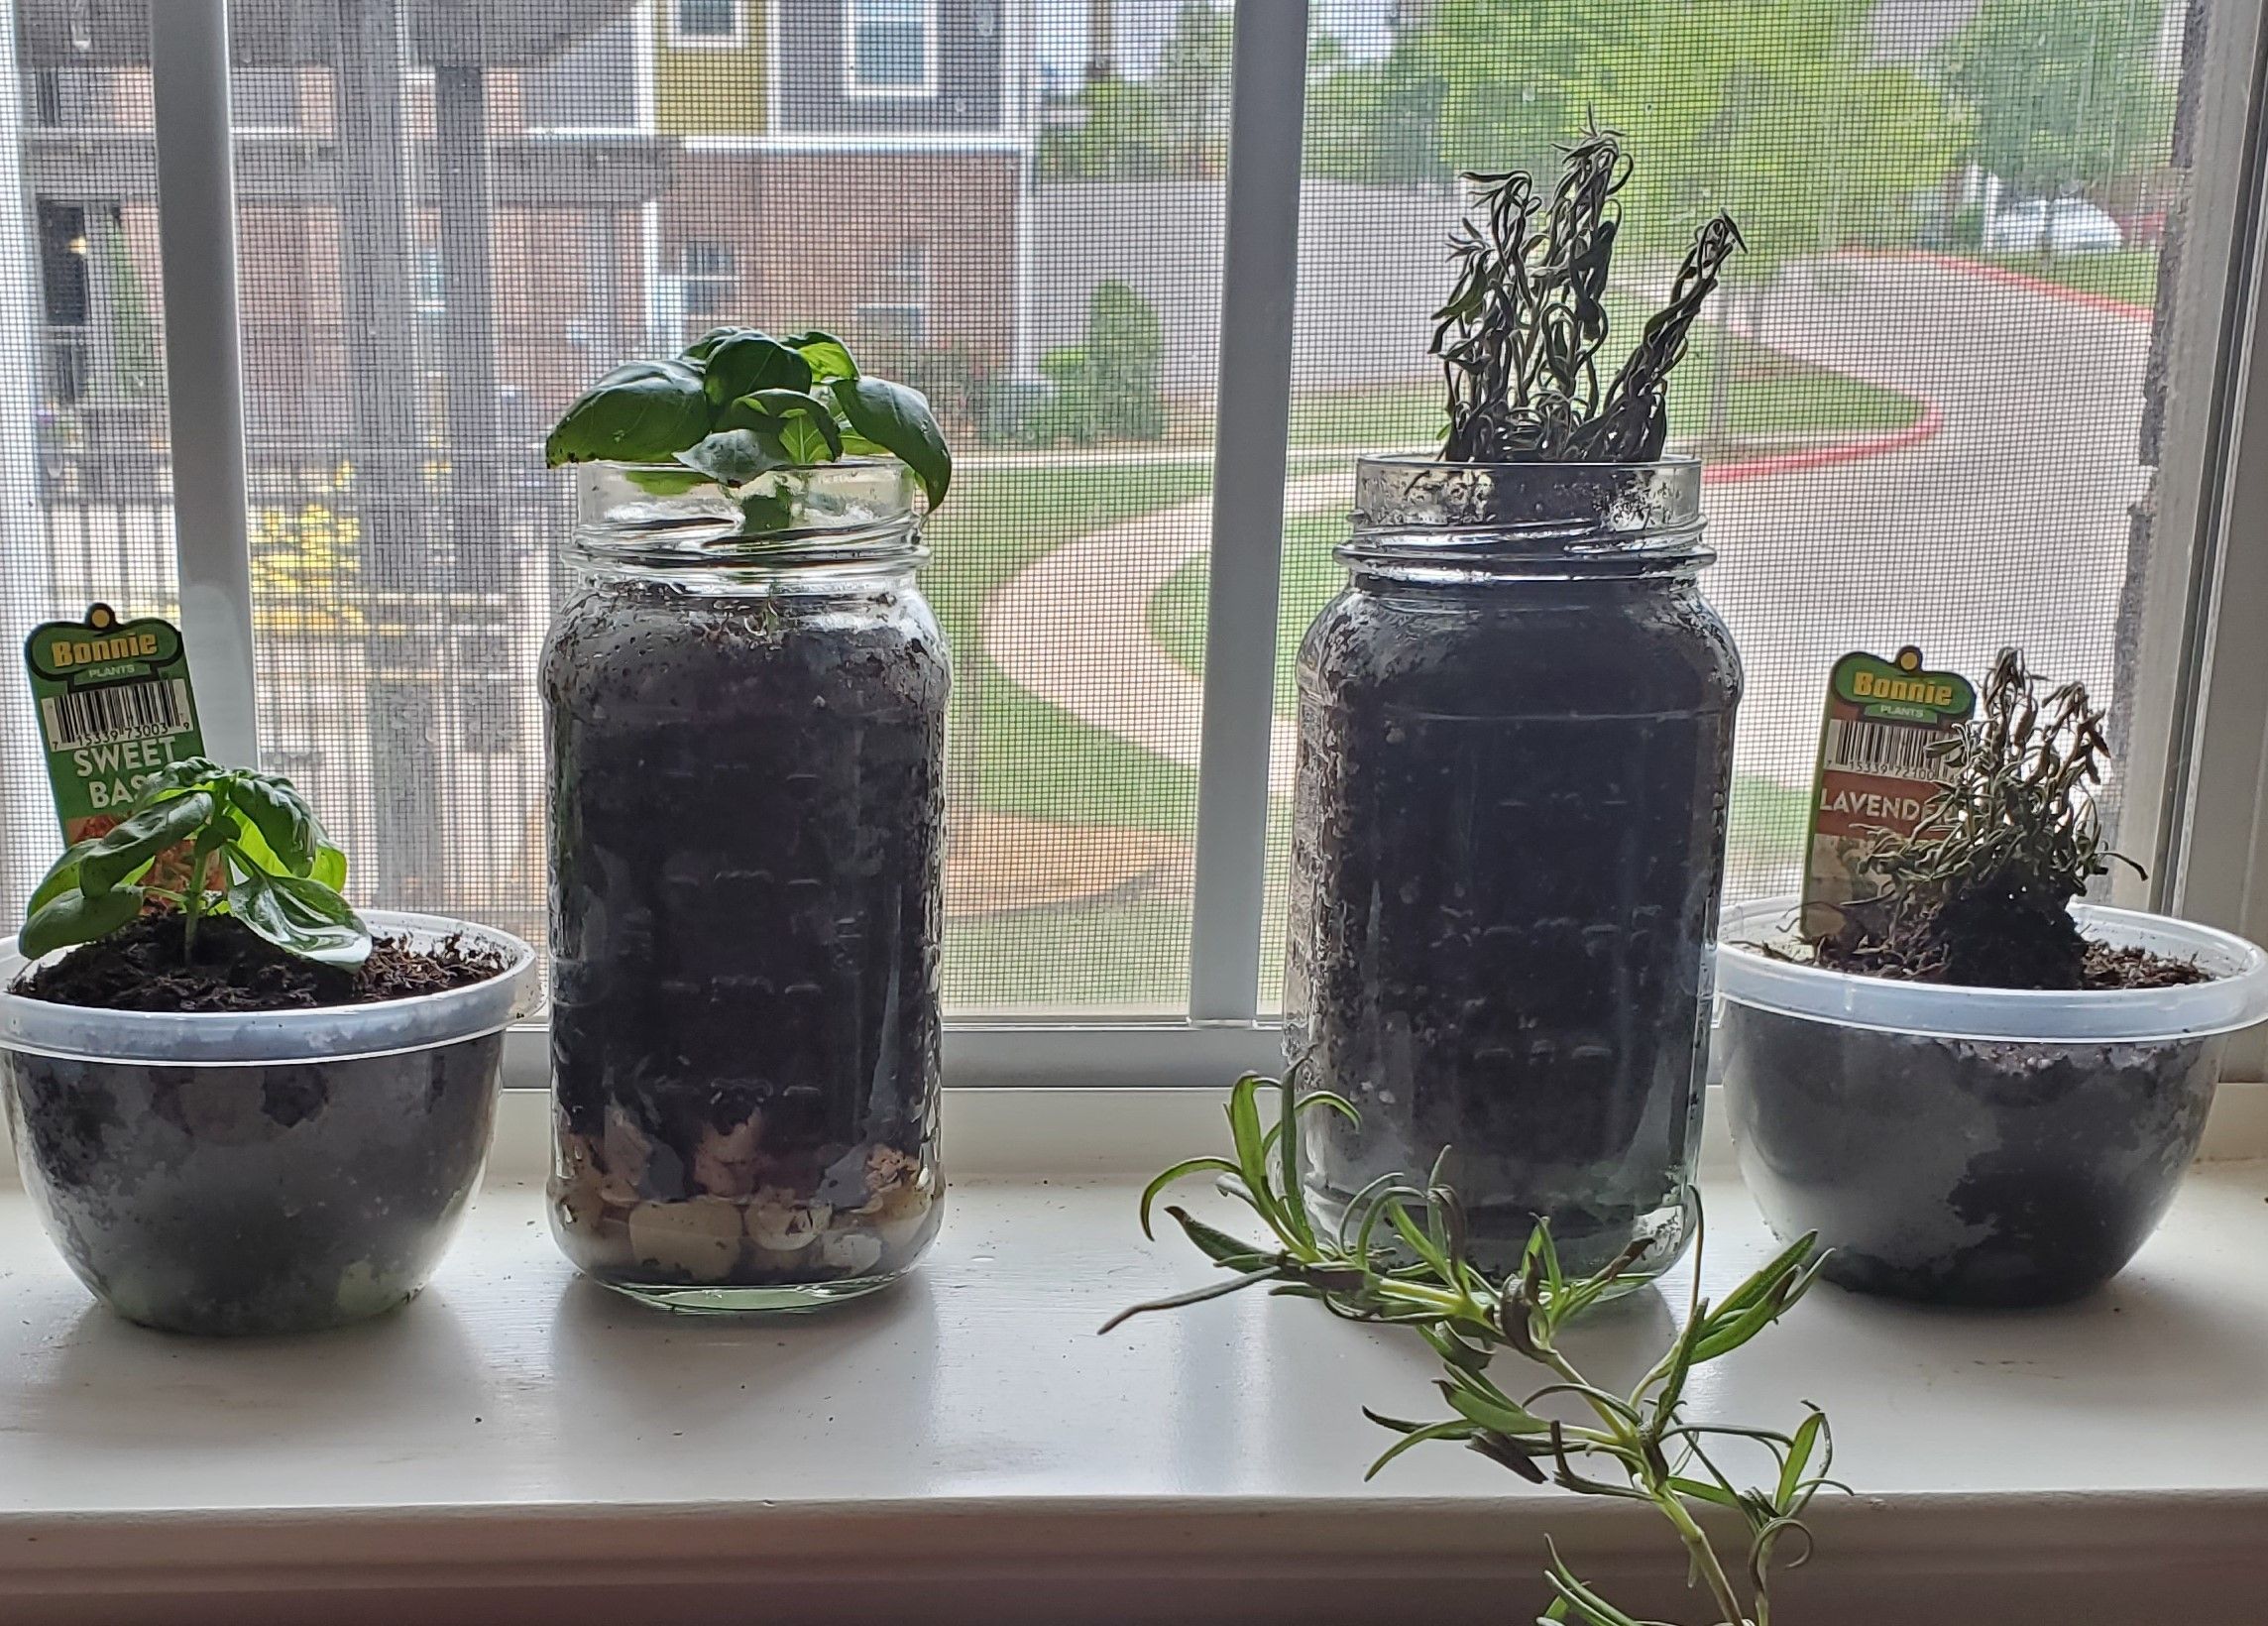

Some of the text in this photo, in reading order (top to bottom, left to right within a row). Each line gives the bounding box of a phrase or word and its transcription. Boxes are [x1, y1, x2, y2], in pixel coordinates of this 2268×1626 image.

[52, 633, 157, 666] Bonnie
[89, 664, 135, 678] PLANTS
[1854, 671, 1952, 705] Bonnie
[1880, 705, 1923, 717] PLANTS
[73, 736, 175, 776] SWEET
